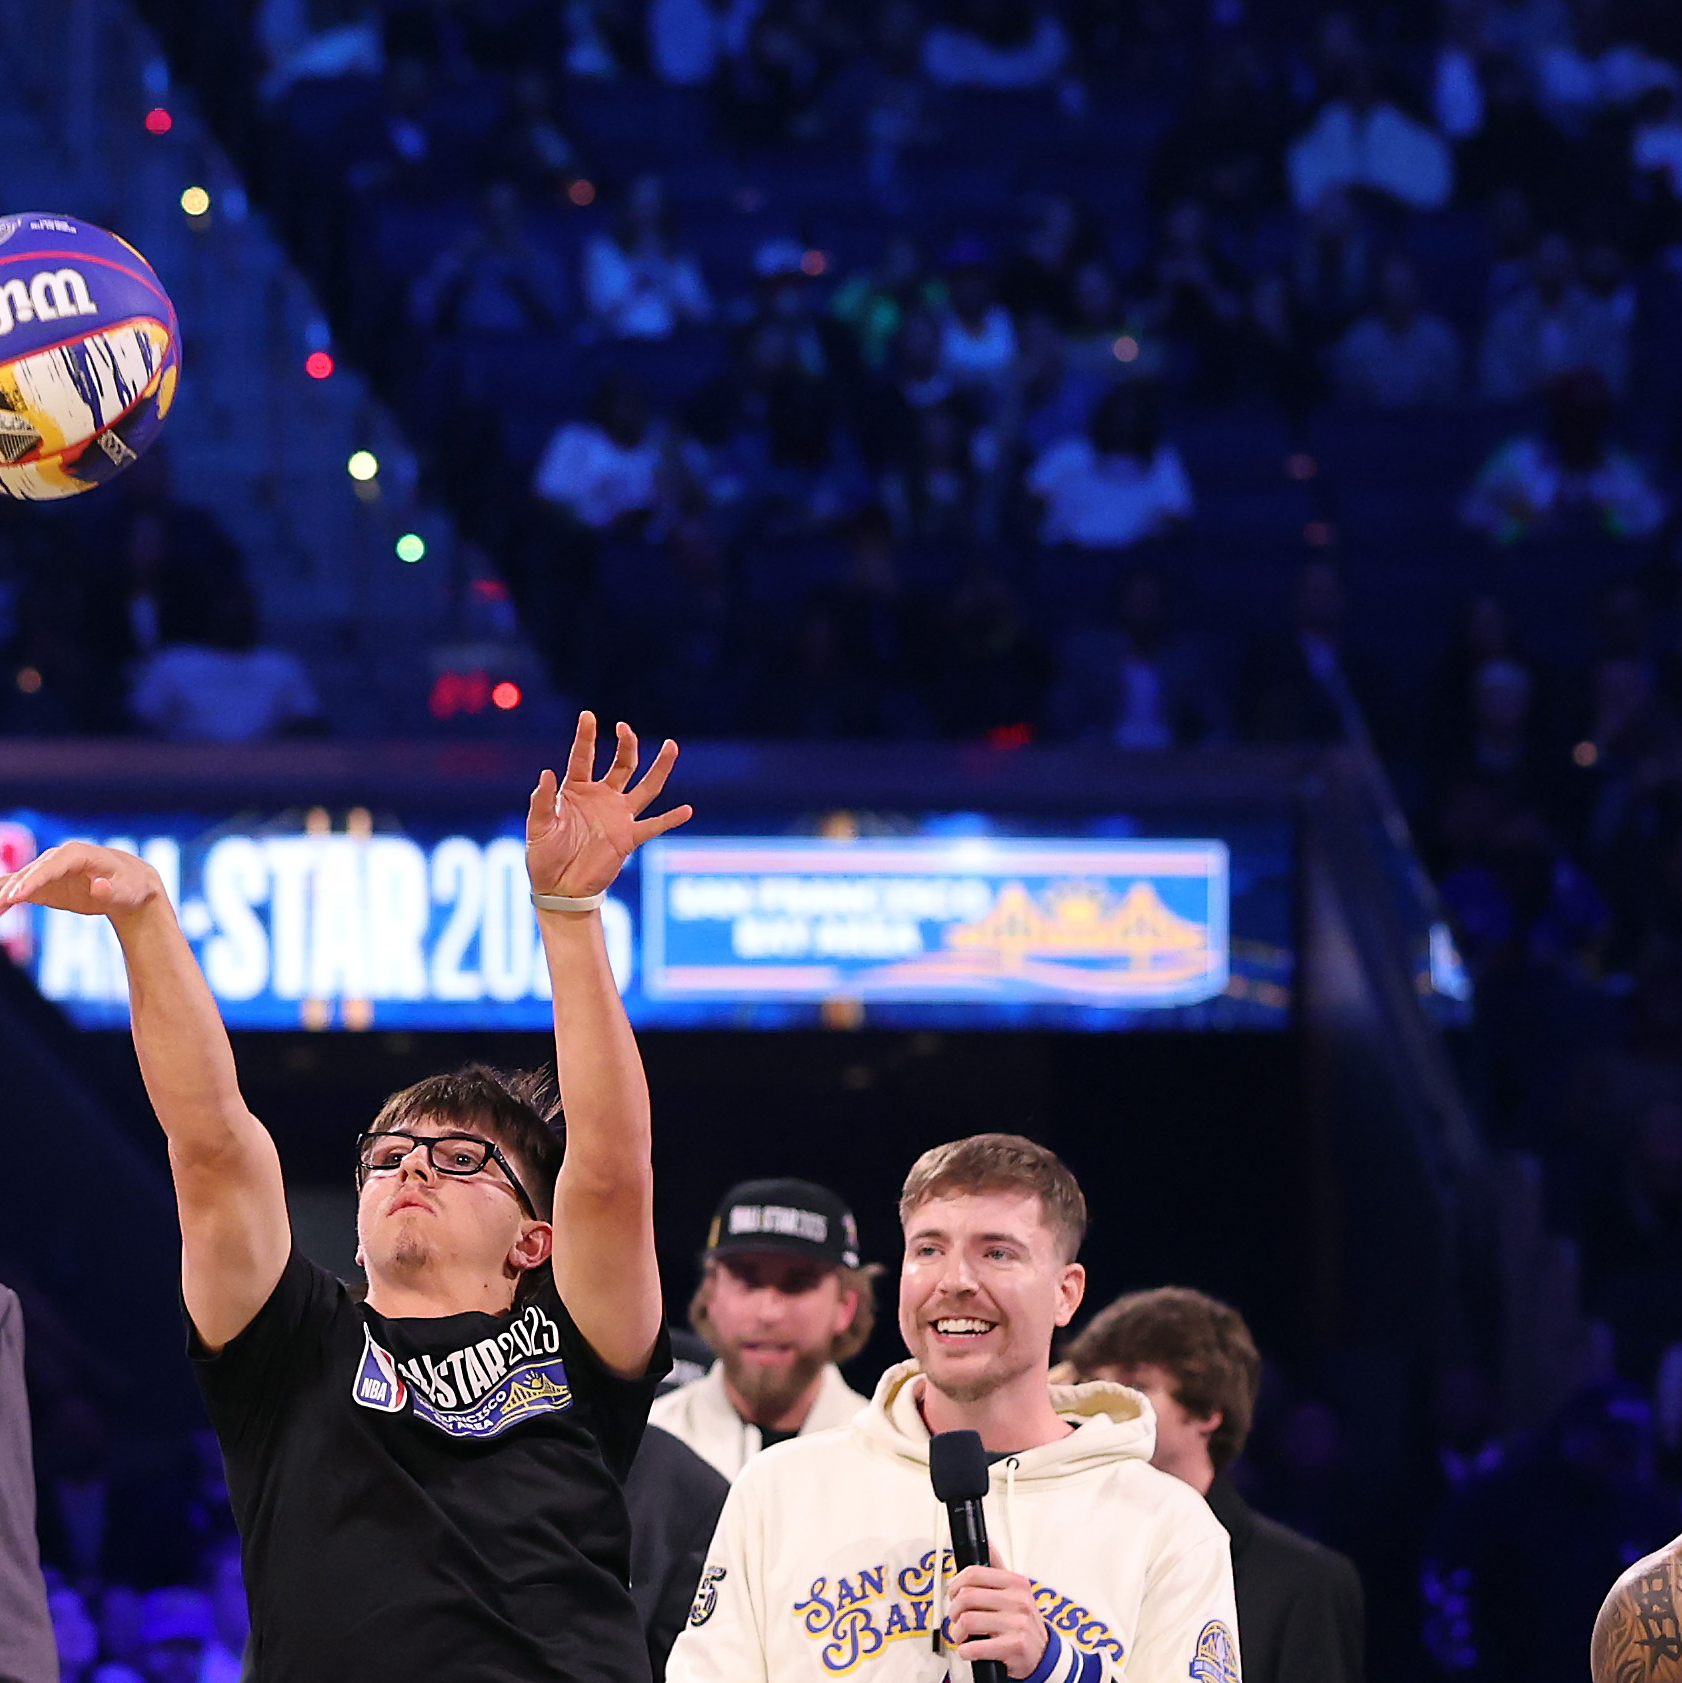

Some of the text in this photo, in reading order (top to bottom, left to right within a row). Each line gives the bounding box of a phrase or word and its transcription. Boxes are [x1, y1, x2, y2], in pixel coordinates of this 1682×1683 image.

[360, 1377, 387, 1402] NBA
[792, 1564, 890, 1640] SAN
[821, 1597, 935, 1678] BAY
